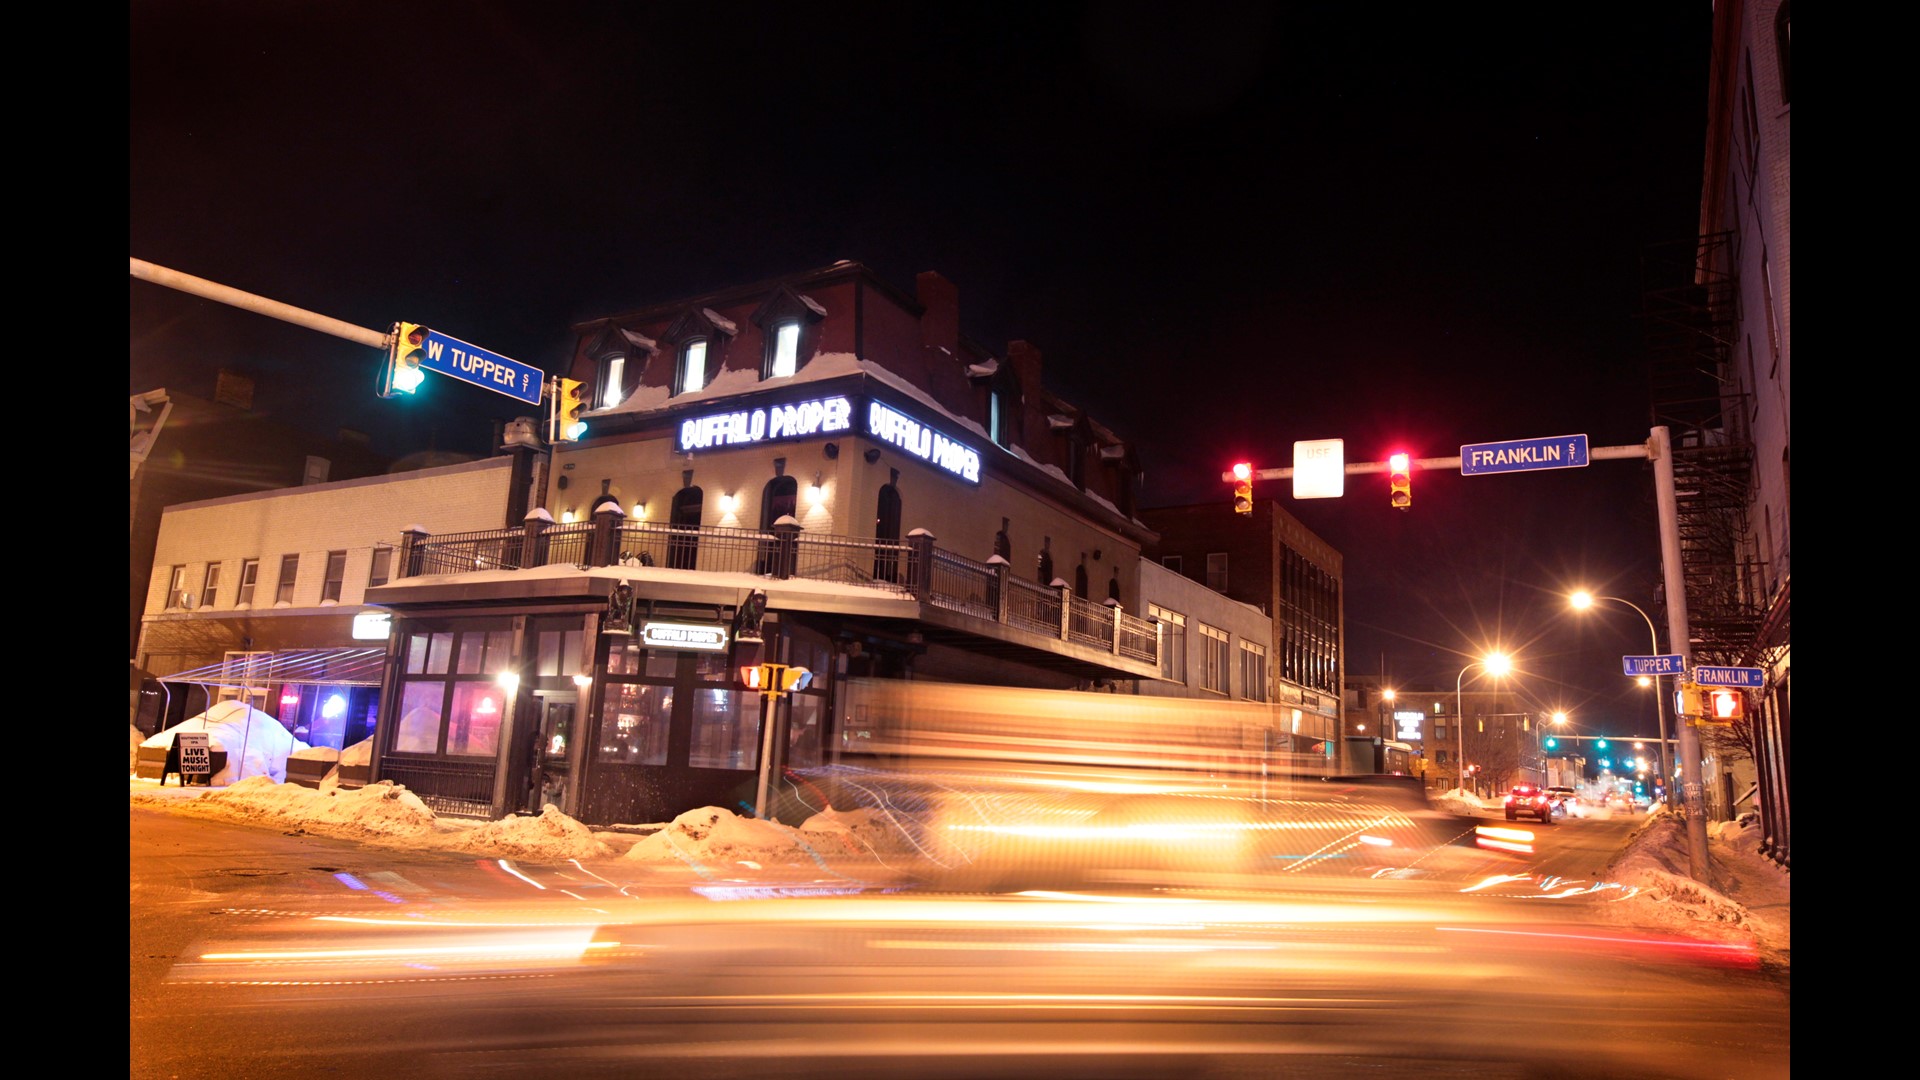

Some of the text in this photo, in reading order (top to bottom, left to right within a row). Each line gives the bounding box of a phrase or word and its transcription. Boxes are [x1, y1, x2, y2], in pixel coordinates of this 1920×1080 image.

[428, 340, 529, 393] W TUPPER ST
[681, 397, 851, 450] BUFFALO PROPER
[869, 402, 980, 484] BUFFALO PROPER
[1472, 443, 1576, 466] FRANKLIN ST
[1634, 658, 1672, 672] TUPPER
[1697, 669, 1749, 684] FRANKLIN
[185, 748, 205, 756] LIVE
